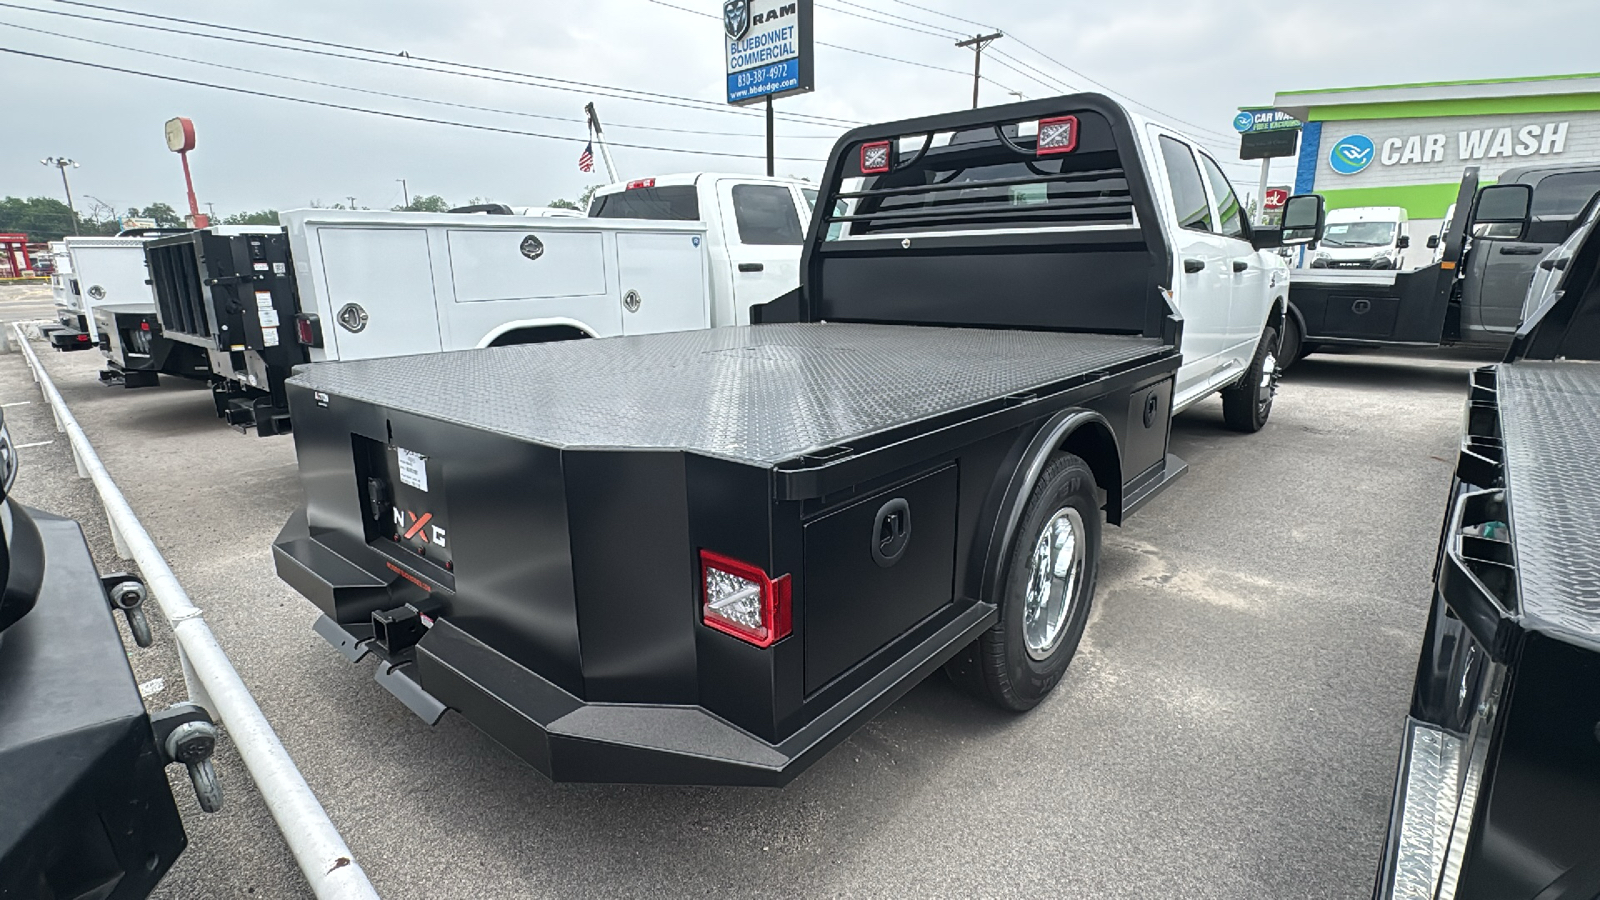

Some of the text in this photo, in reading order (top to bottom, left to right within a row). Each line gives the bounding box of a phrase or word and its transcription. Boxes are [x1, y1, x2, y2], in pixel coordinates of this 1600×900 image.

[753, 3, 796, 26] RAM
[730, 25, 794, 55] BLUEBONNET
[730, 41, 795, 69] COMMERCIAL
[730, 78, 797, 99] www.bbdodge.com
[737, 63, 788, 88] 830-387-4972
[1254, 112, 1273, 123] CAR
[1381, 122, 1569, 166] CAR WASH
[392, 506, 446, 548] NXG
